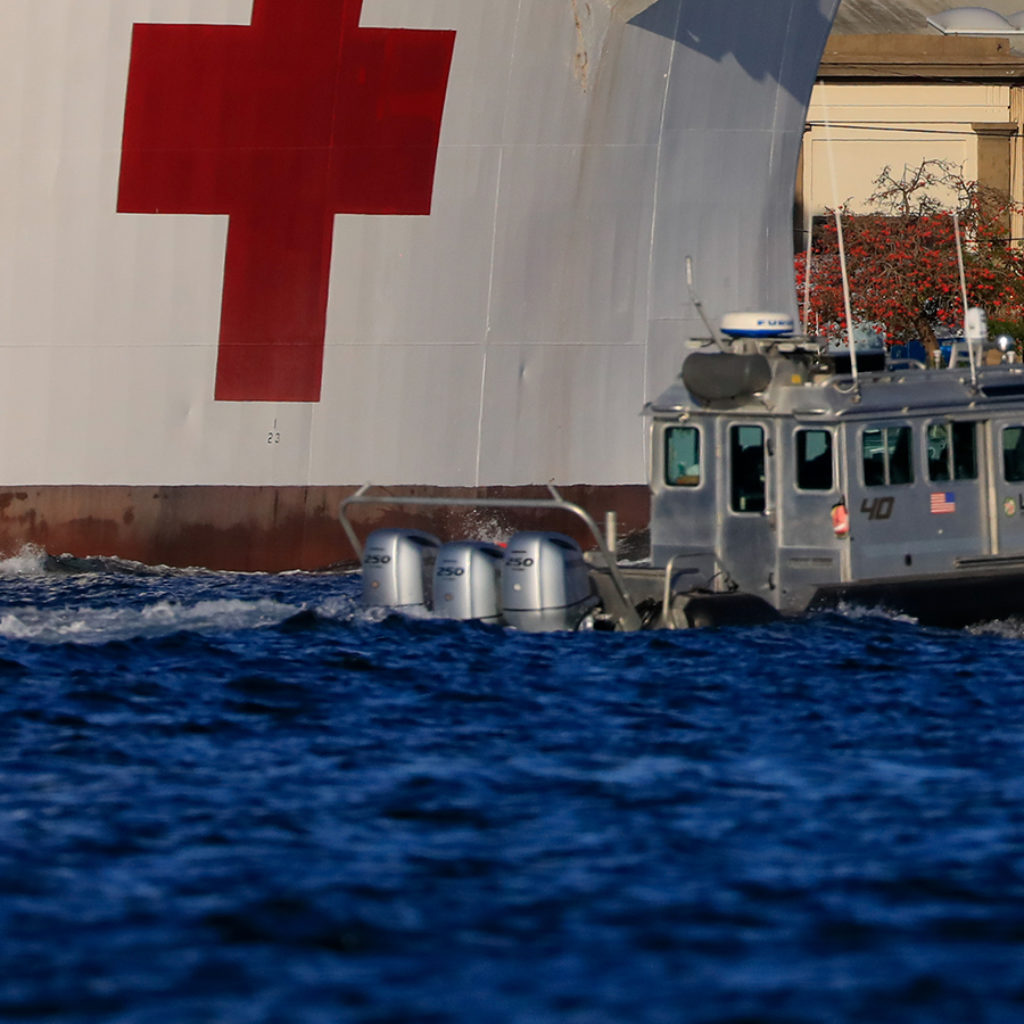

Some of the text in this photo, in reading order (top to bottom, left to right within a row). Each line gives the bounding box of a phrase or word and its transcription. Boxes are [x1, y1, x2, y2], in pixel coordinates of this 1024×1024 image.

[860, 496, 895, 521] 40
[364, 554, 391, 564] 250
[506, 557, 534, 567] 250
[436, 566, 464, 577] 250
